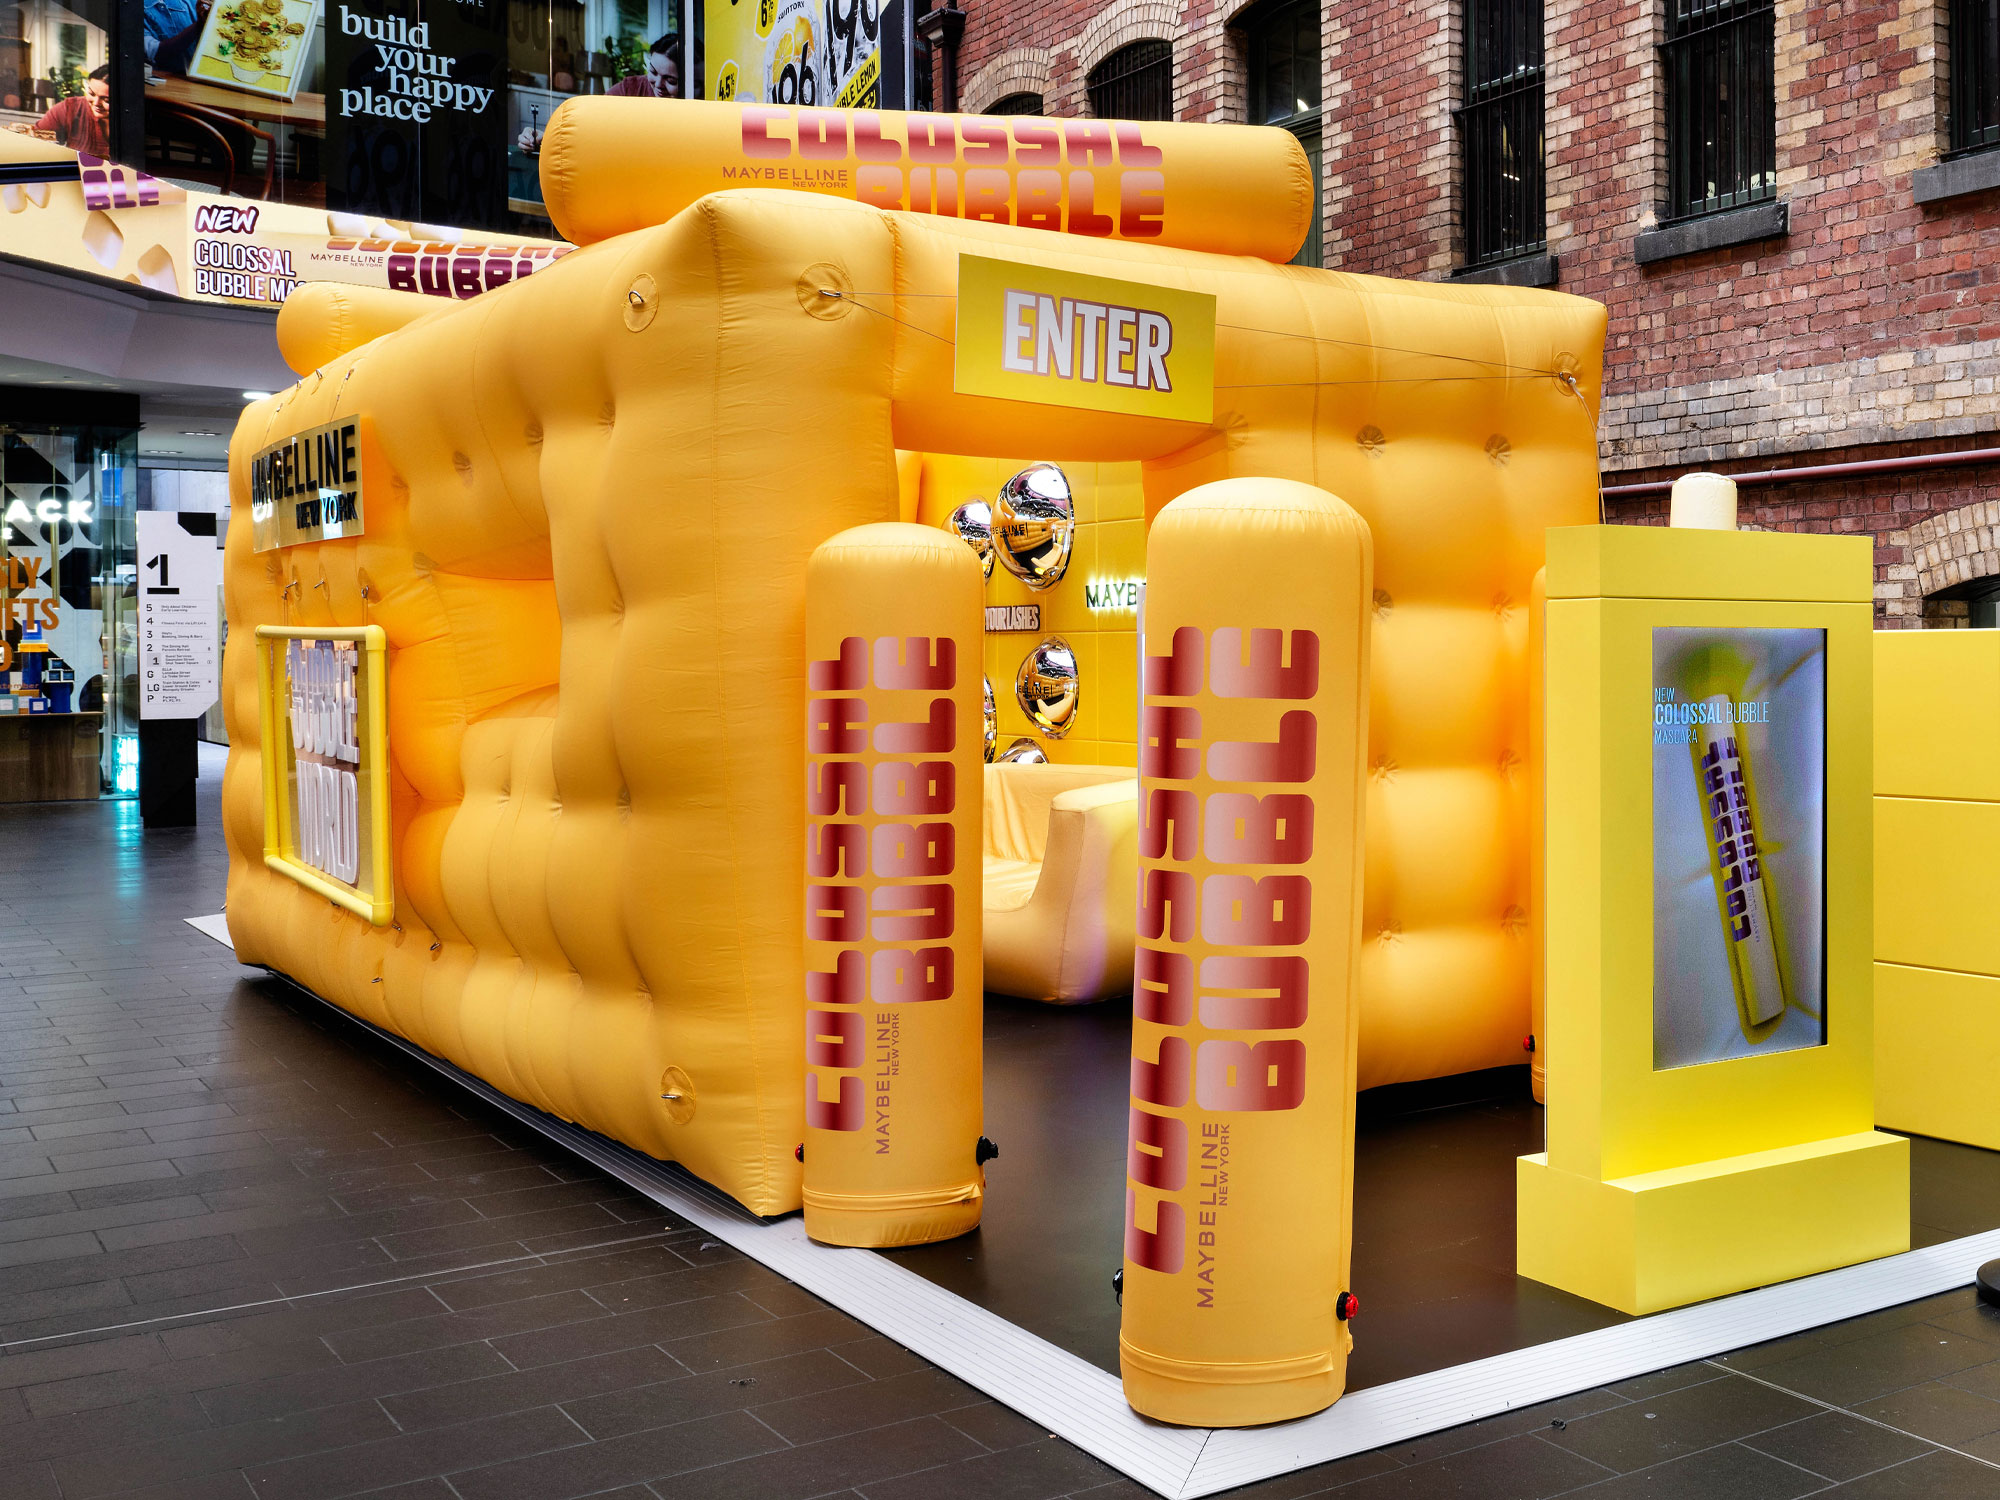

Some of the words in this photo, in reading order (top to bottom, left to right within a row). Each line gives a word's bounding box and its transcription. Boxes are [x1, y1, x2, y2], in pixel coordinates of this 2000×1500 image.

[339, 5, 431, 49] build
[375, 44, 456, 78] your
[855, 59, 876, 95] LEMON
[340, 87, 431, 123] place
[388, 65, 494, 113] happy
[742, 105, 1163, 167] COLOSSAL
[722, 165, 848, 182] MAYBELLINE
[818, 181, 848, 189] YORK
[195, 206, 258, 233] NEW
[194, 239, 297, 277] COLOSSAL
[310, 253, 384, 265] MAYBELLINE
[195, 268, 269, 301] BUBBLE
[1003, 289, 1173, 393] ENTER
[252, 424, 357, 508] MAYBELLINE
[296, 499, 321, 530] NEW
[321, 491, 358, 525] YORK
[146, 554, 180, 594] 1
[146, 603, 153, 612] 5
[146, 616, 154, 625] 4
[1007, 605, 1039, 630] LASHES
[146, 630, 153, 639] 3
[146, 643, 153, 652] 2
[147, 670, 154, 679] G
[153, 657, 160, 666] 1
[147, 683, 160, 692] LG
[147, 694, 154, 703] P
[1654, 687, 1675, 703] NEW
[1654, 703, 1723, 725] COLOSSAL
[1726, 701, 1770, 724] BUBBLE
[1654, 728, 1698, 745] MASCARA
[870, 636, 957, 1004] BUBBLE
[1718, 737, 1761, 883] BUBBLE
[1701, 740, 1752, 943] COLOSSAL
[804, 636, 869, 1132] COLOSSAL
[1195, 626, 1321, 1112] BUBBLE
[1125, 626, 1206, 1275] COLOSSAL
[891, 1011, 900, 1046] YORK
[891, 1047, 900, 1077] NEW
[875, 1011, 892, 1155] MAYBELLINE
[1219, 1123, 1231, 1164] YORK
[1217, 1168, 1231, 1208] NEW
[1196, 1121, 1220, 1308] MAYBELLINE
